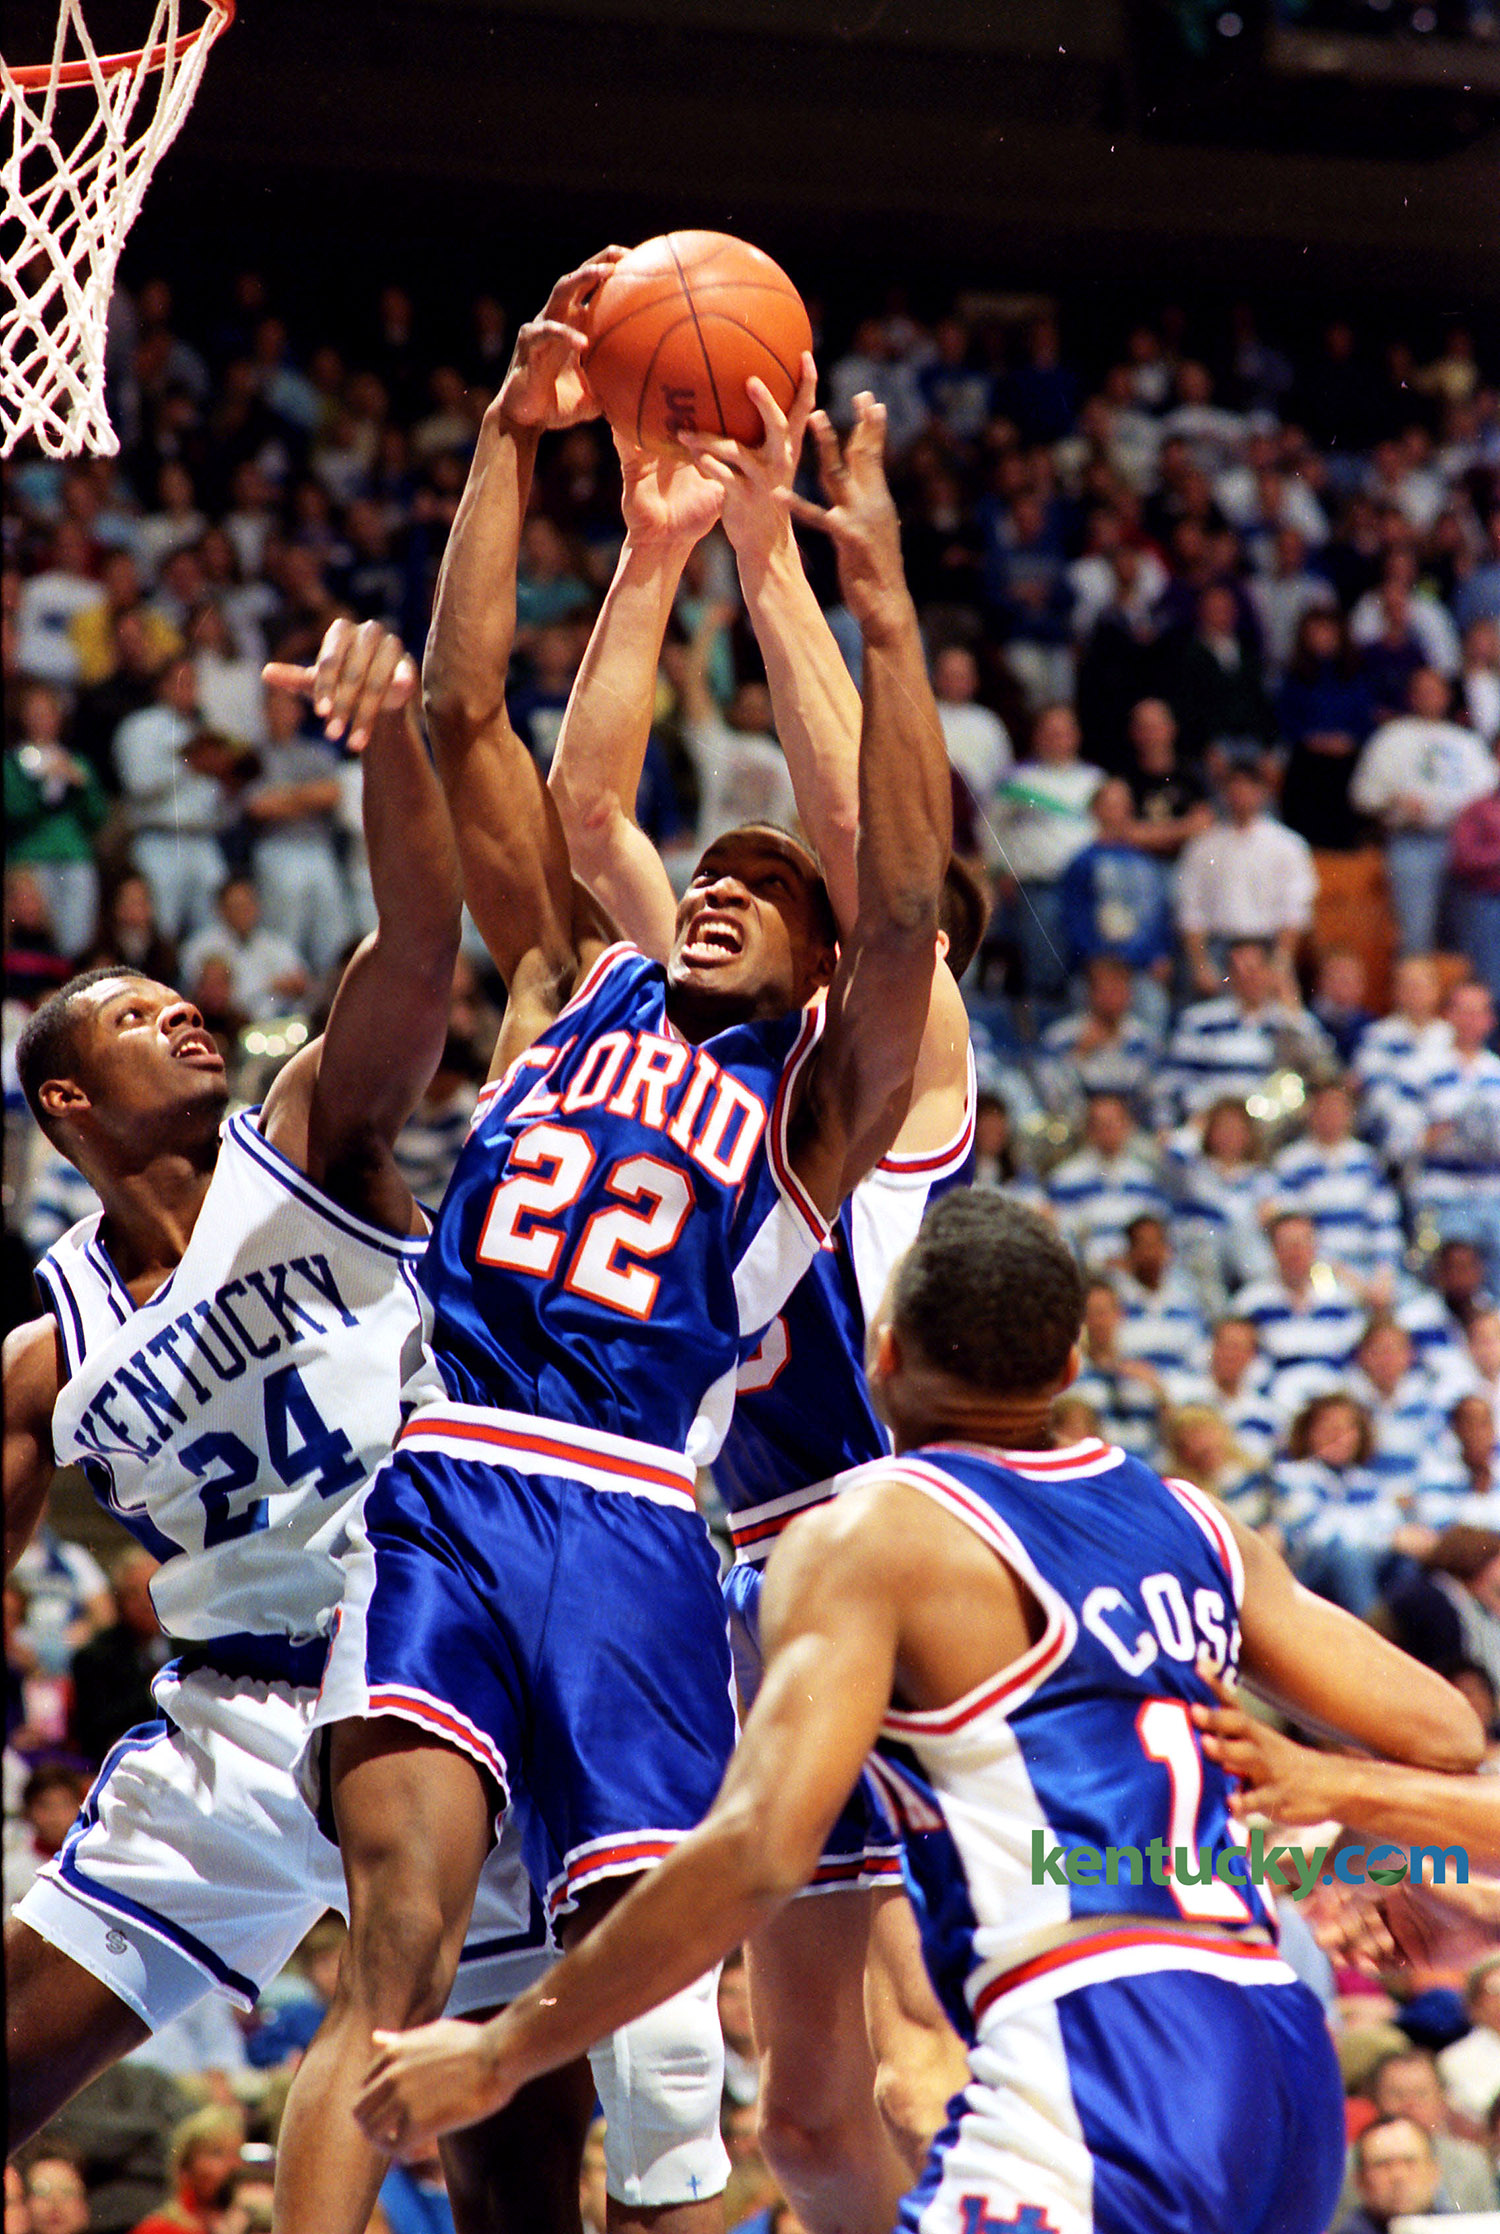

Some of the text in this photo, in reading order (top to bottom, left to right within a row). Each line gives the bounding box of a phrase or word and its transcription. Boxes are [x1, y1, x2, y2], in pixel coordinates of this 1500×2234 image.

[476, 1121, 696, 1321] 22
[74, 1254, 360, 1464] KENTUCKY
[178, 1363, 367, 1549] 24
